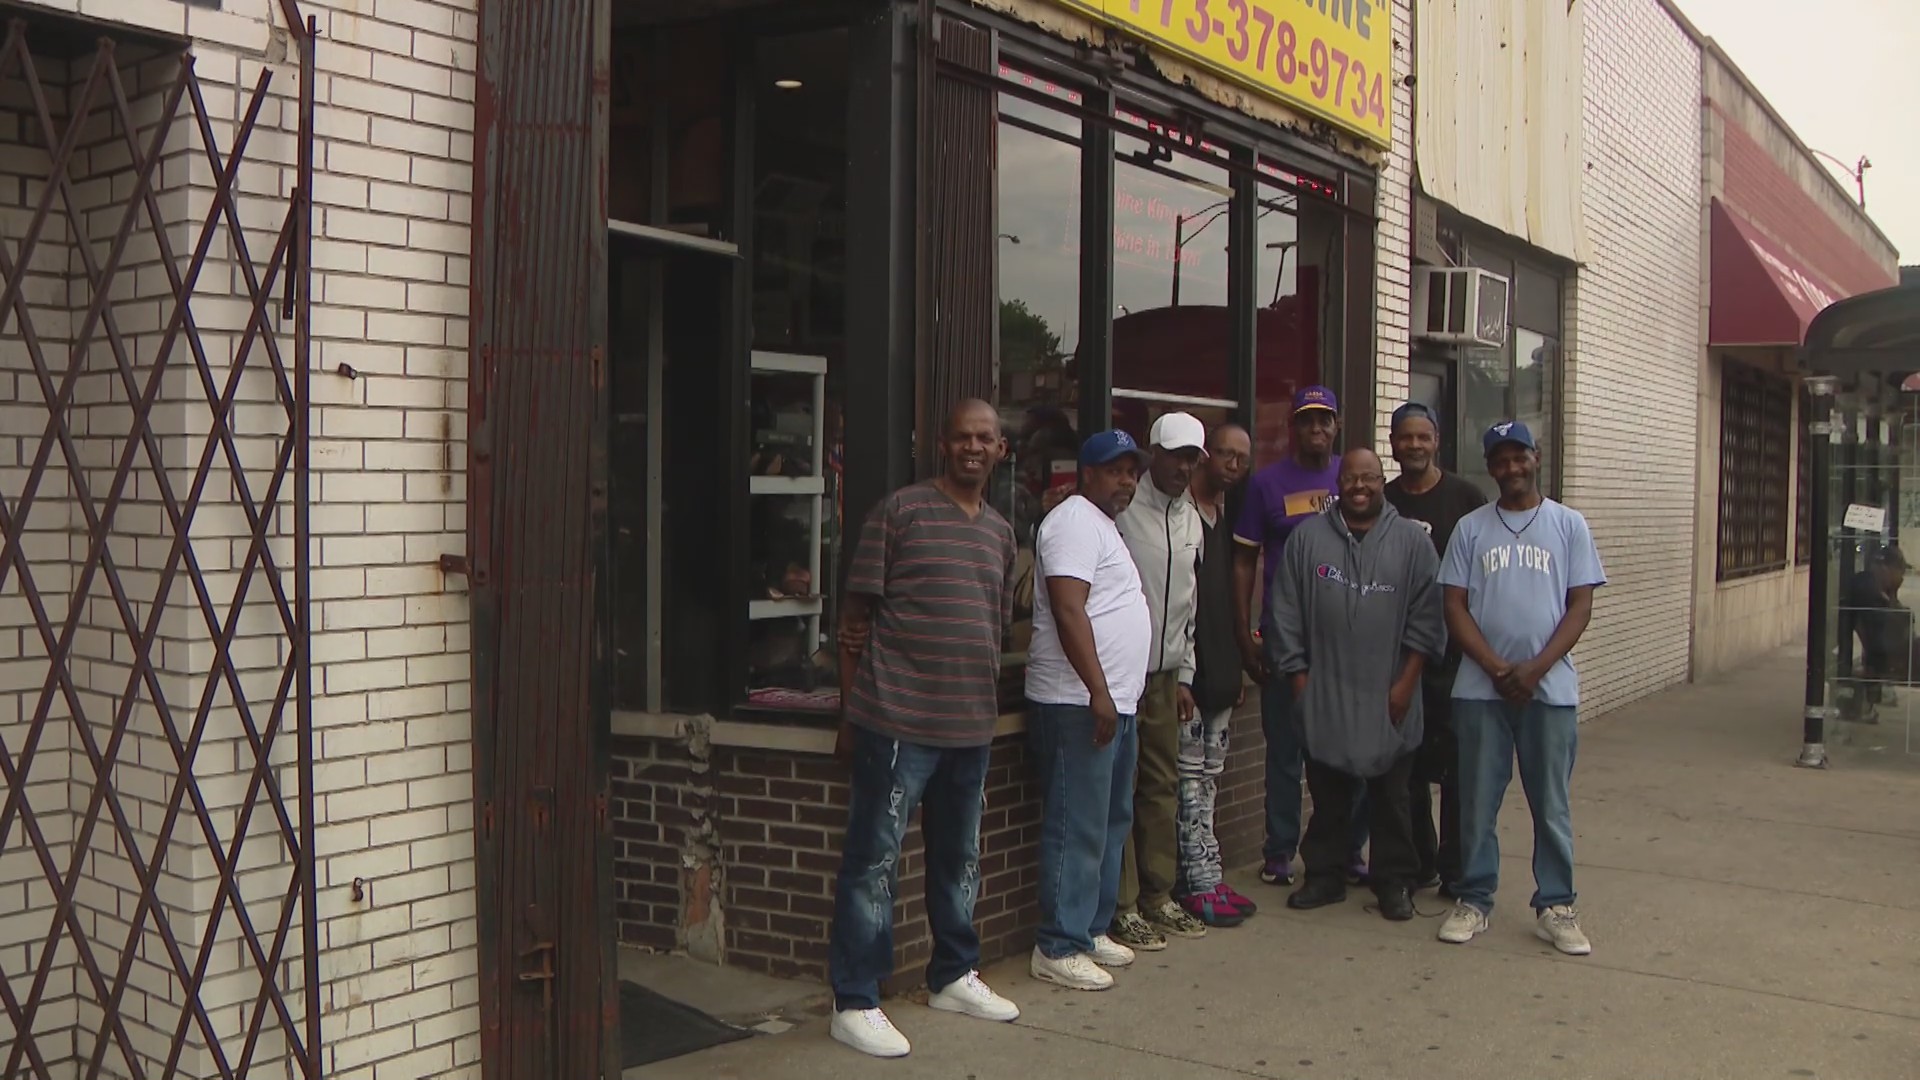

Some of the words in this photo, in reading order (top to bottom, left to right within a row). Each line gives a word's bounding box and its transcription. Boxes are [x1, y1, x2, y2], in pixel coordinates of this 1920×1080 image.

[1128, 0, 1385, 128] 3-378-9734
[1482, 544, 1511, 577] NEW
[1516, 544, 1550, 575] YORK
